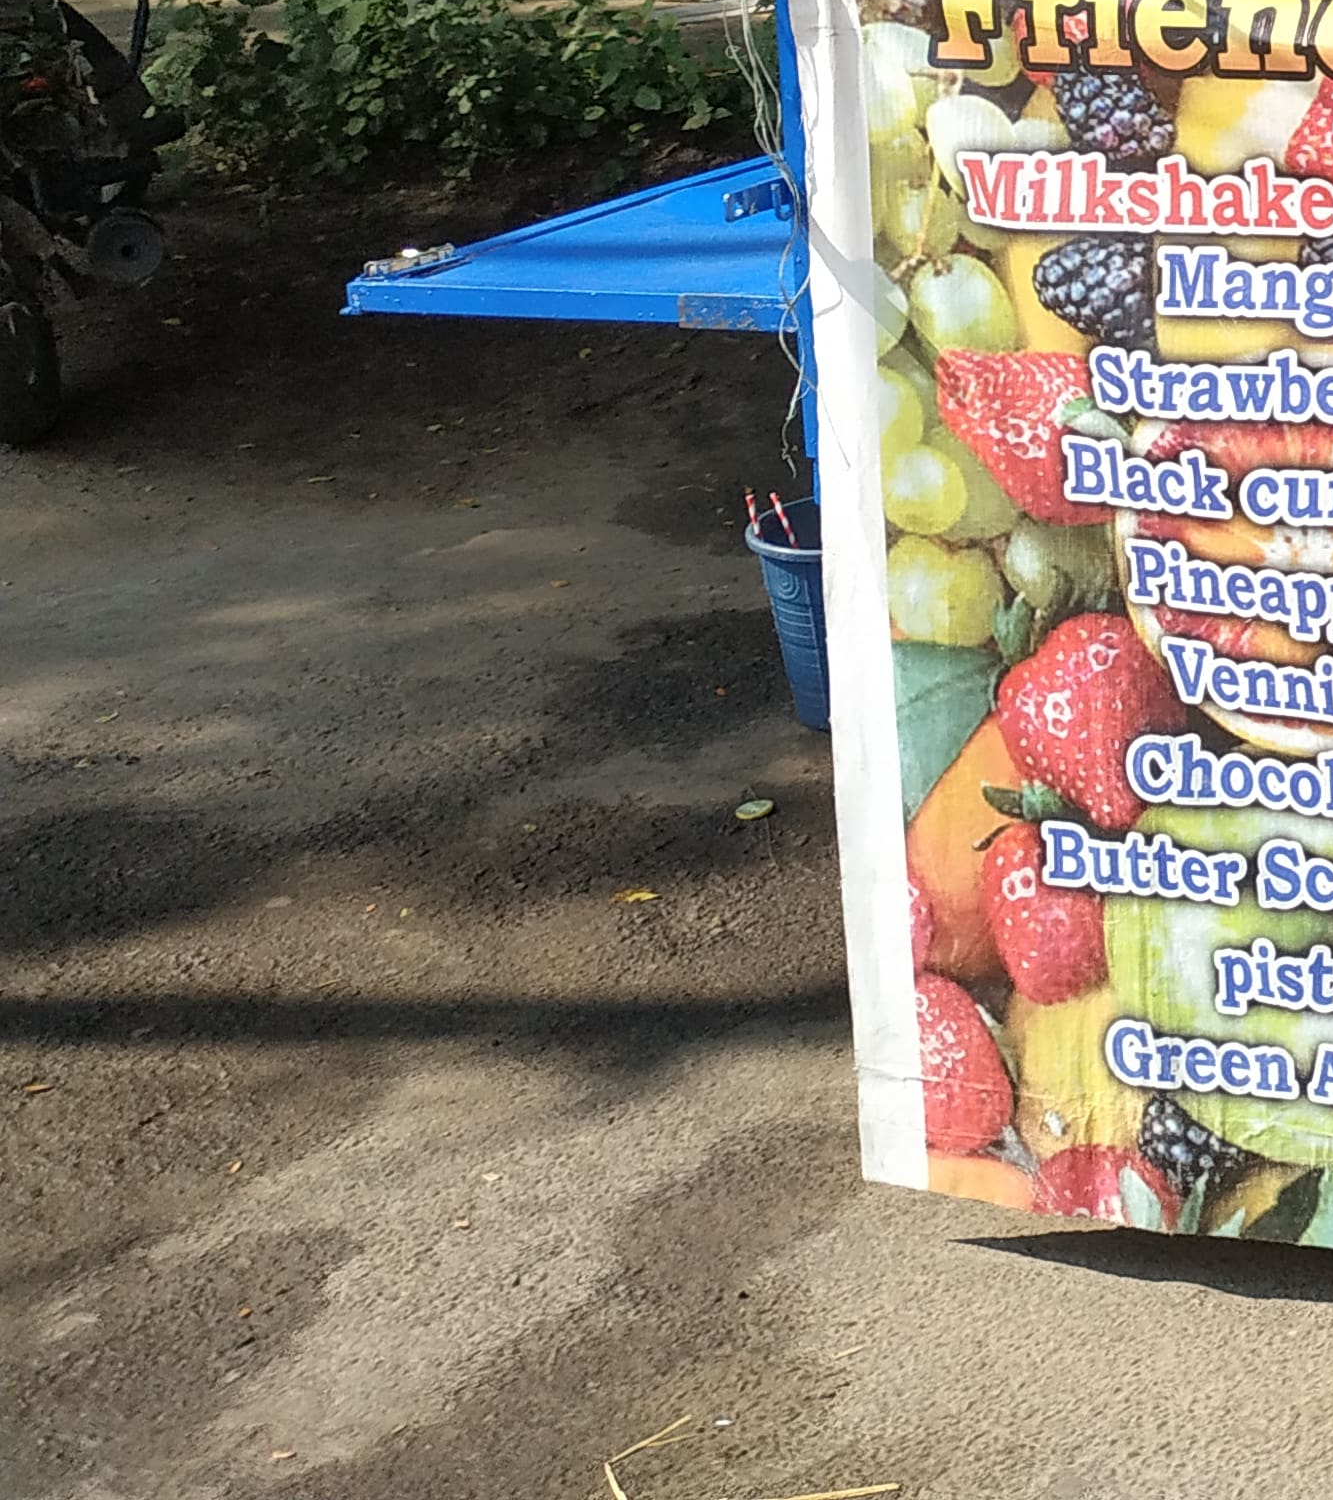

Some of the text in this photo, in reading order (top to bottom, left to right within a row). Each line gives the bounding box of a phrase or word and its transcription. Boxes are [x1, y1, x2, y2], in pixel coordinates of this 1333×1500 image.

[1068, 442, 1227, 513] Black
[1047, 827, 1241, 900] Butter
[1111, 1026, 1293, 1093] Green
